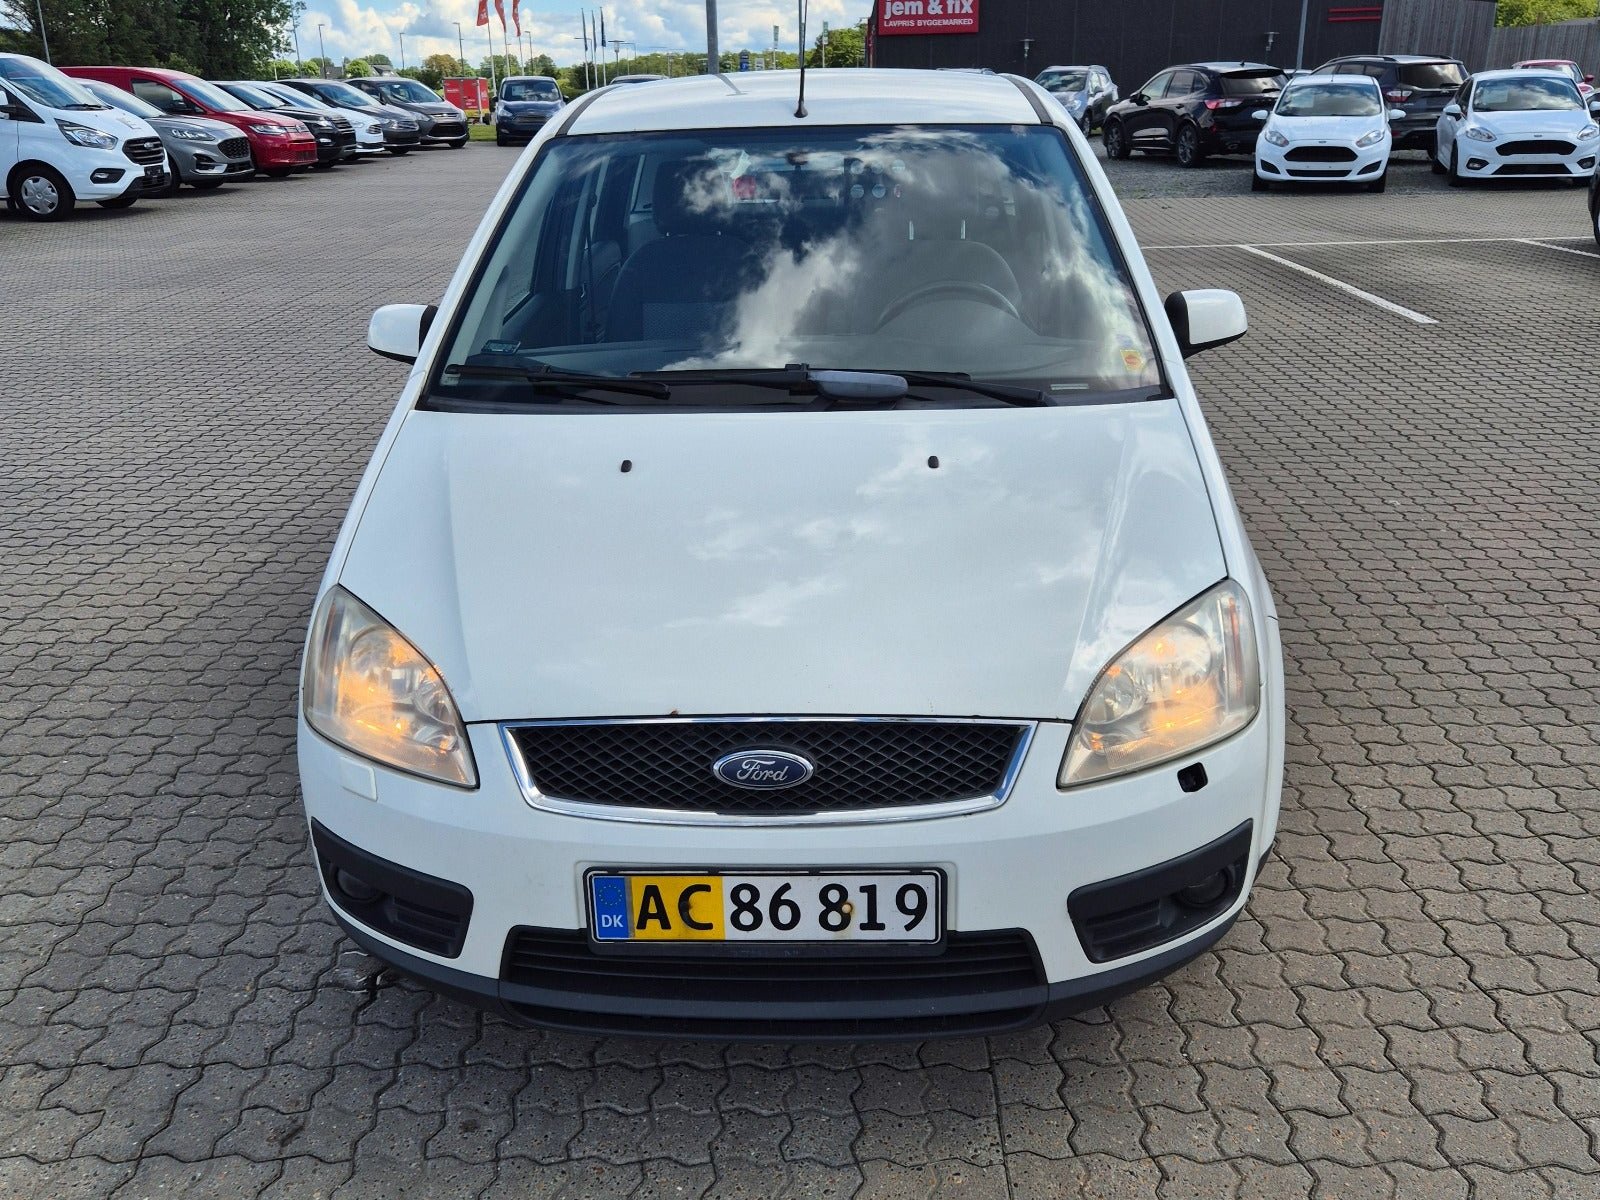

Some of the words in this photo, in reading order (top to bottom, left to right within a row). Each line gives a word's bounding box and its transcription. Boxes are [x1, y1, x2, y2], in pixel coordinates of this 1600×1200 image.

[884, 0, 923, 19] jem
[927, 0, 943, 14] &
[947, 0, 973, 14] fix
[884, 19, 915, 27] LAVPRIS
[917, 18, 974, 27] BYGGEMARKED
[736, 759, 788, 781] Ford
[636, 883, 714, 931] AC
[729, 882, 801, 932] 86
[818, 882, 928, 932] 819
[601, 914, 624, 928] DK
